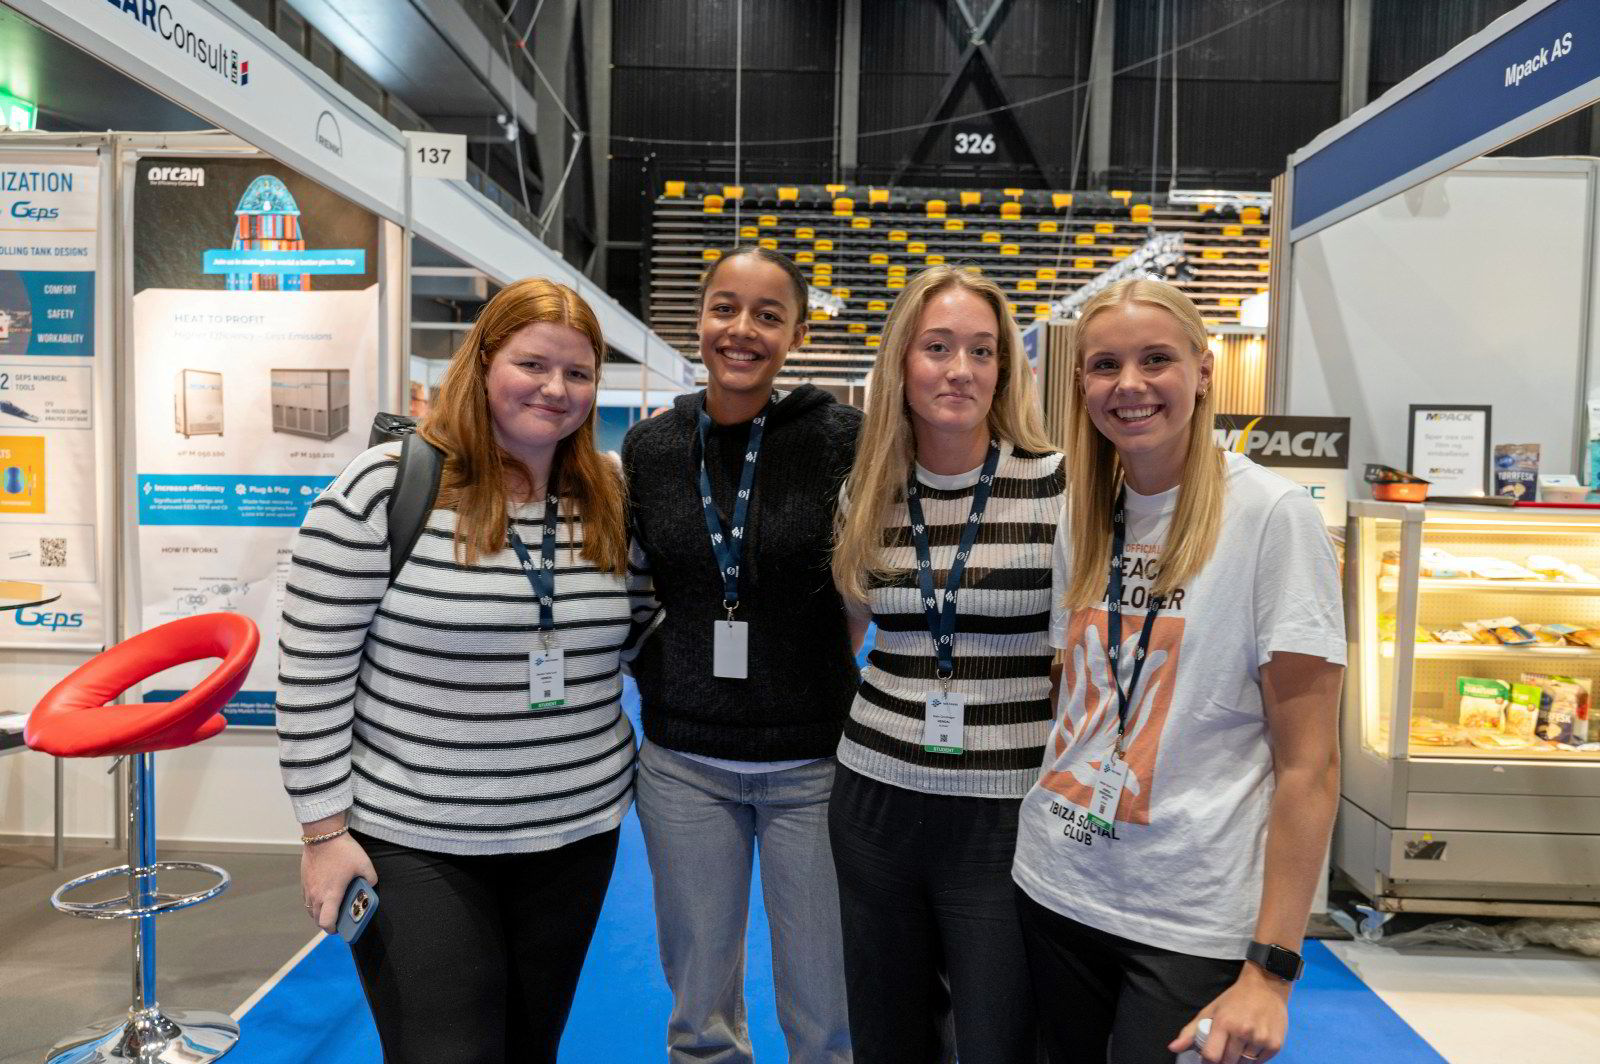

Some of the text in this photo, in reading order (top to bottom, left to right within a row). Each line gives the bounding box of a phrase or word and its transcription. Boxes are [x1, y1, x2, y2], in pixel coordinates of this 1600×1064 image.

[1504, 32, 1572, 87] Mpack AS
[954, 132, 996, 154] 326
[417, 147, 452, 164] 137
[148, 166, 205, 186] orcan
[31, 247, 53, 256] TANK
[54, 247, 88, 257] DESIGNS
[44, 284, 77, 294] COMFORT
[47, 308, 74, 319] SAFETY
[174, 314, 265, 324] HEAT TO PROFIT
[37, 333, 84, 343] WORKABILITY
[287, 332, 333, 341] Emissions
[1426, 413, 1473, 421] MPACK
[1212, 429, 1343, 458] MPACK
[154, 484, 225, 494] Increase efficiency
[249, 485, 266, 494] Plug
[273, 486, 290, 495] Play
[1049, 801, 1075, 824] IBIZA
[1063, 824, 1093, 846] CLUB
